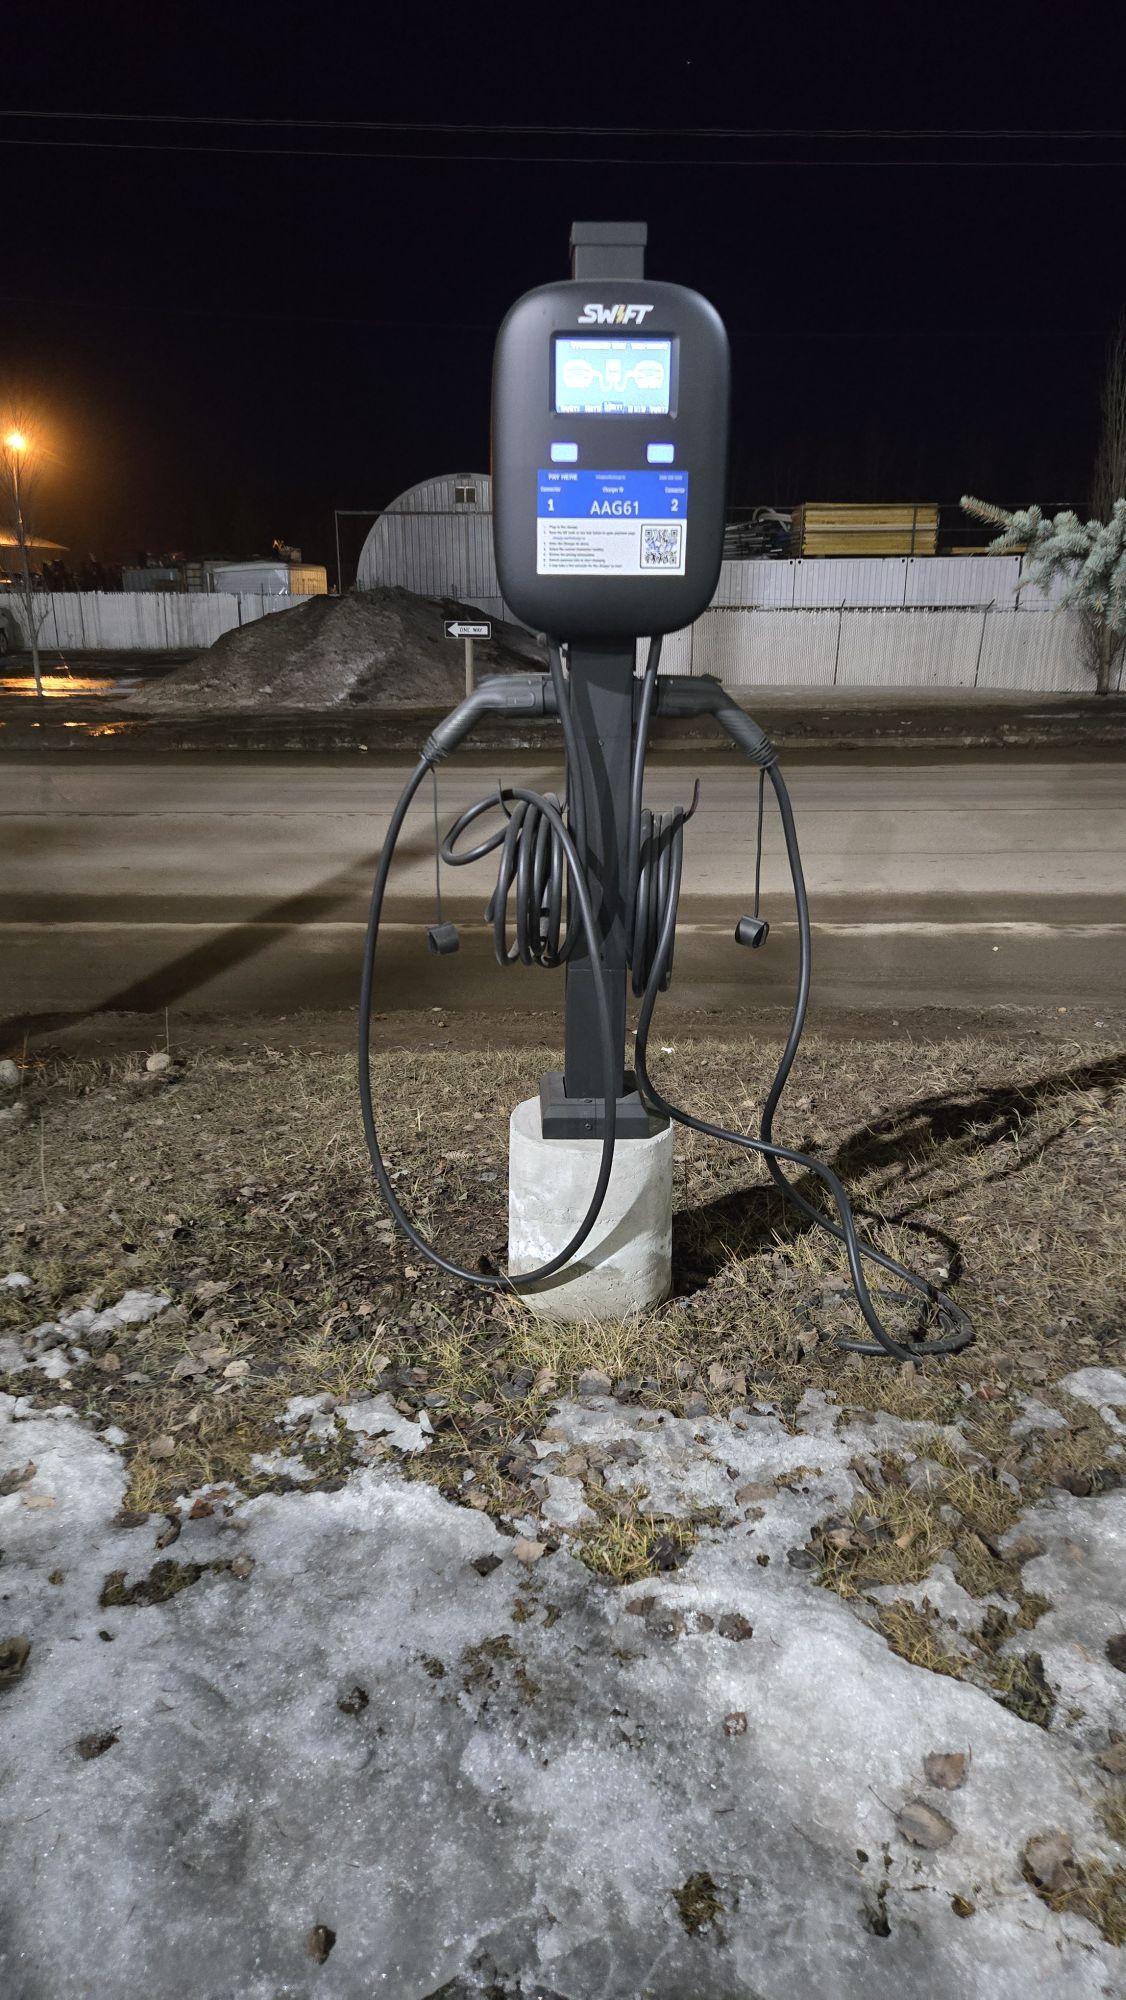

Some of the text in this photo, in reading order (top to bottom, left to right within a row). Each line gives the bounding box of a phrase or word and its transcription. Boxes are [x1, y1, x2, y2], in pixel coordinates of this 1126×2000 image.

[577, 303, 655, 325] SWIFT
[548, 472, 578, 481] PAY HERE
[547, 498, 554, 512] 1
[590, 500, 639, 515] AAG61
[671, 498, 679, 512] 2
